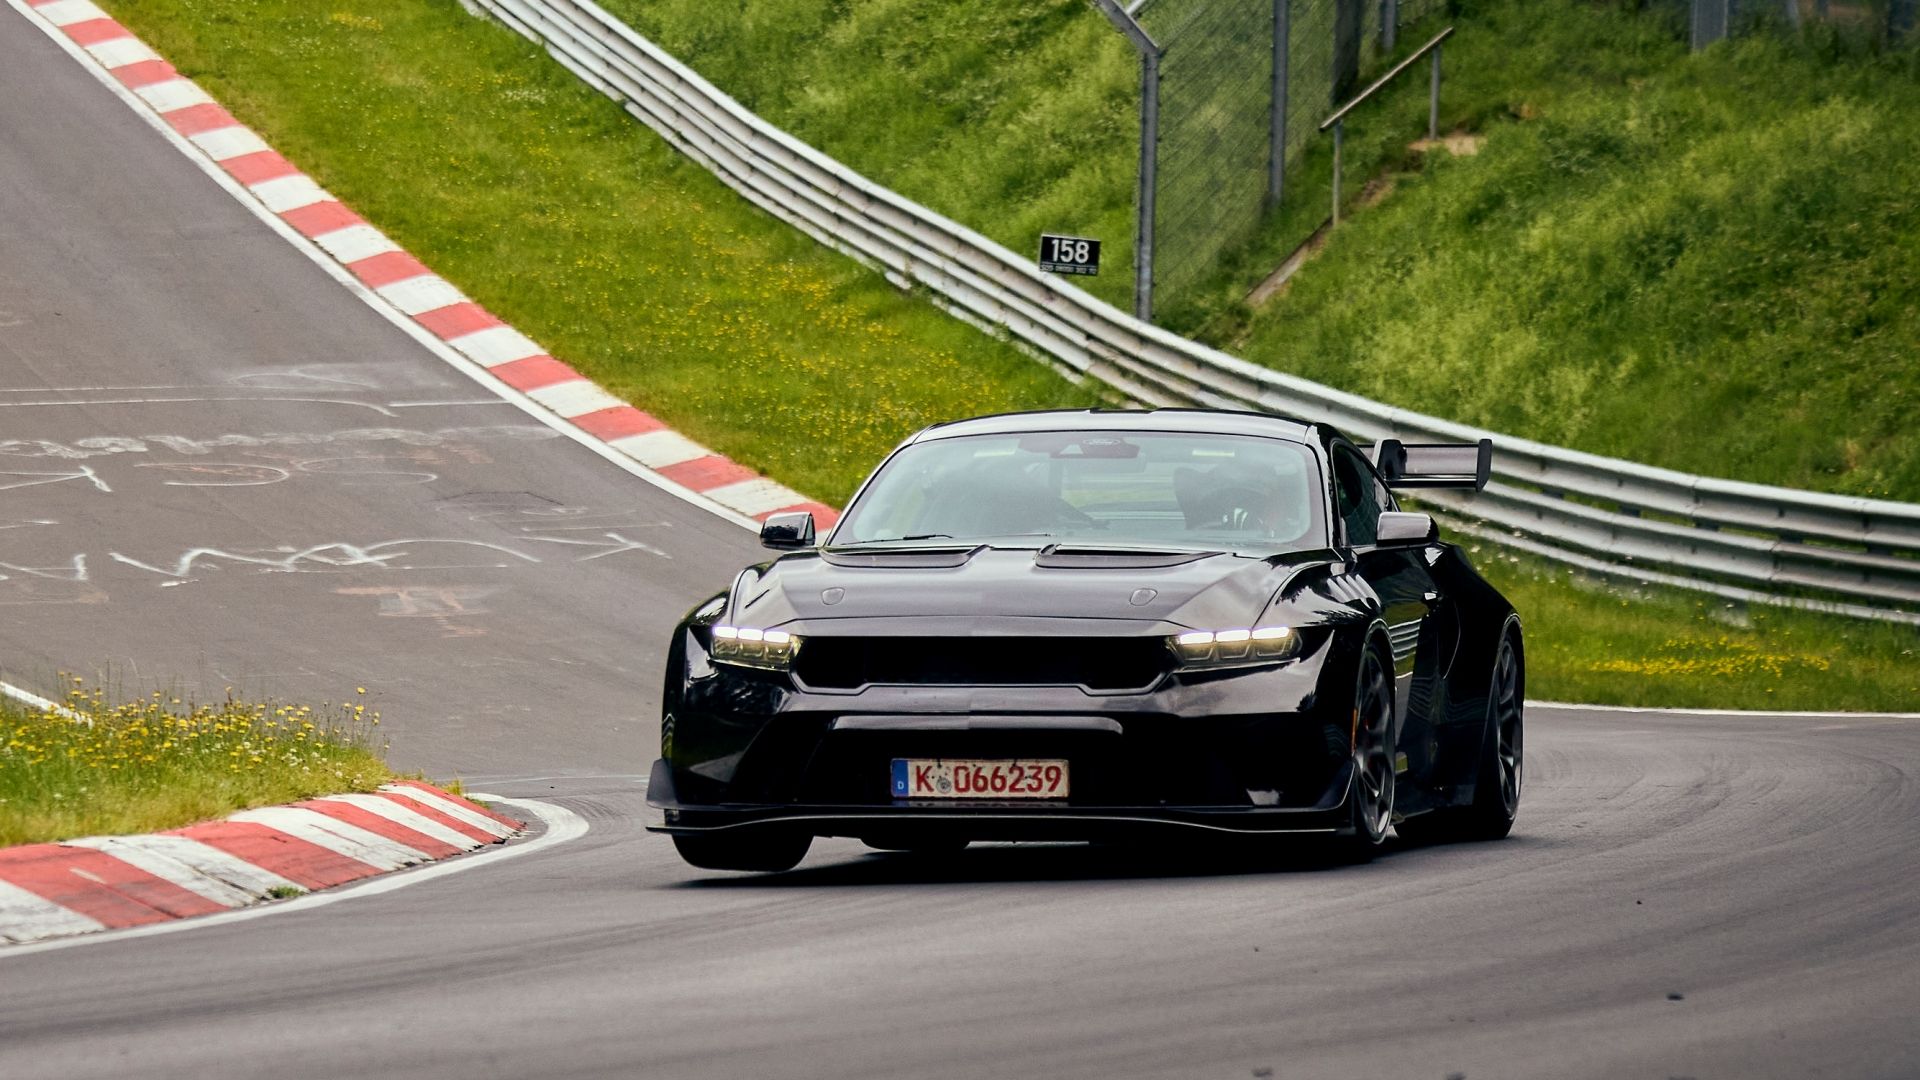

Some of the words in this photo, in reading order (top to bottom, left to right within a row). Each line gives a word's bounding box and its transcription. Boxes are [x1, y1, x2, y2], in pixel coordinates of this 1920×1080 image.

[1052, 239, 1089, 263] 158
[897, 780, 905, 790] D
[915, 765, 935, 792] K
[953, 765, 1062, 793] 066239
